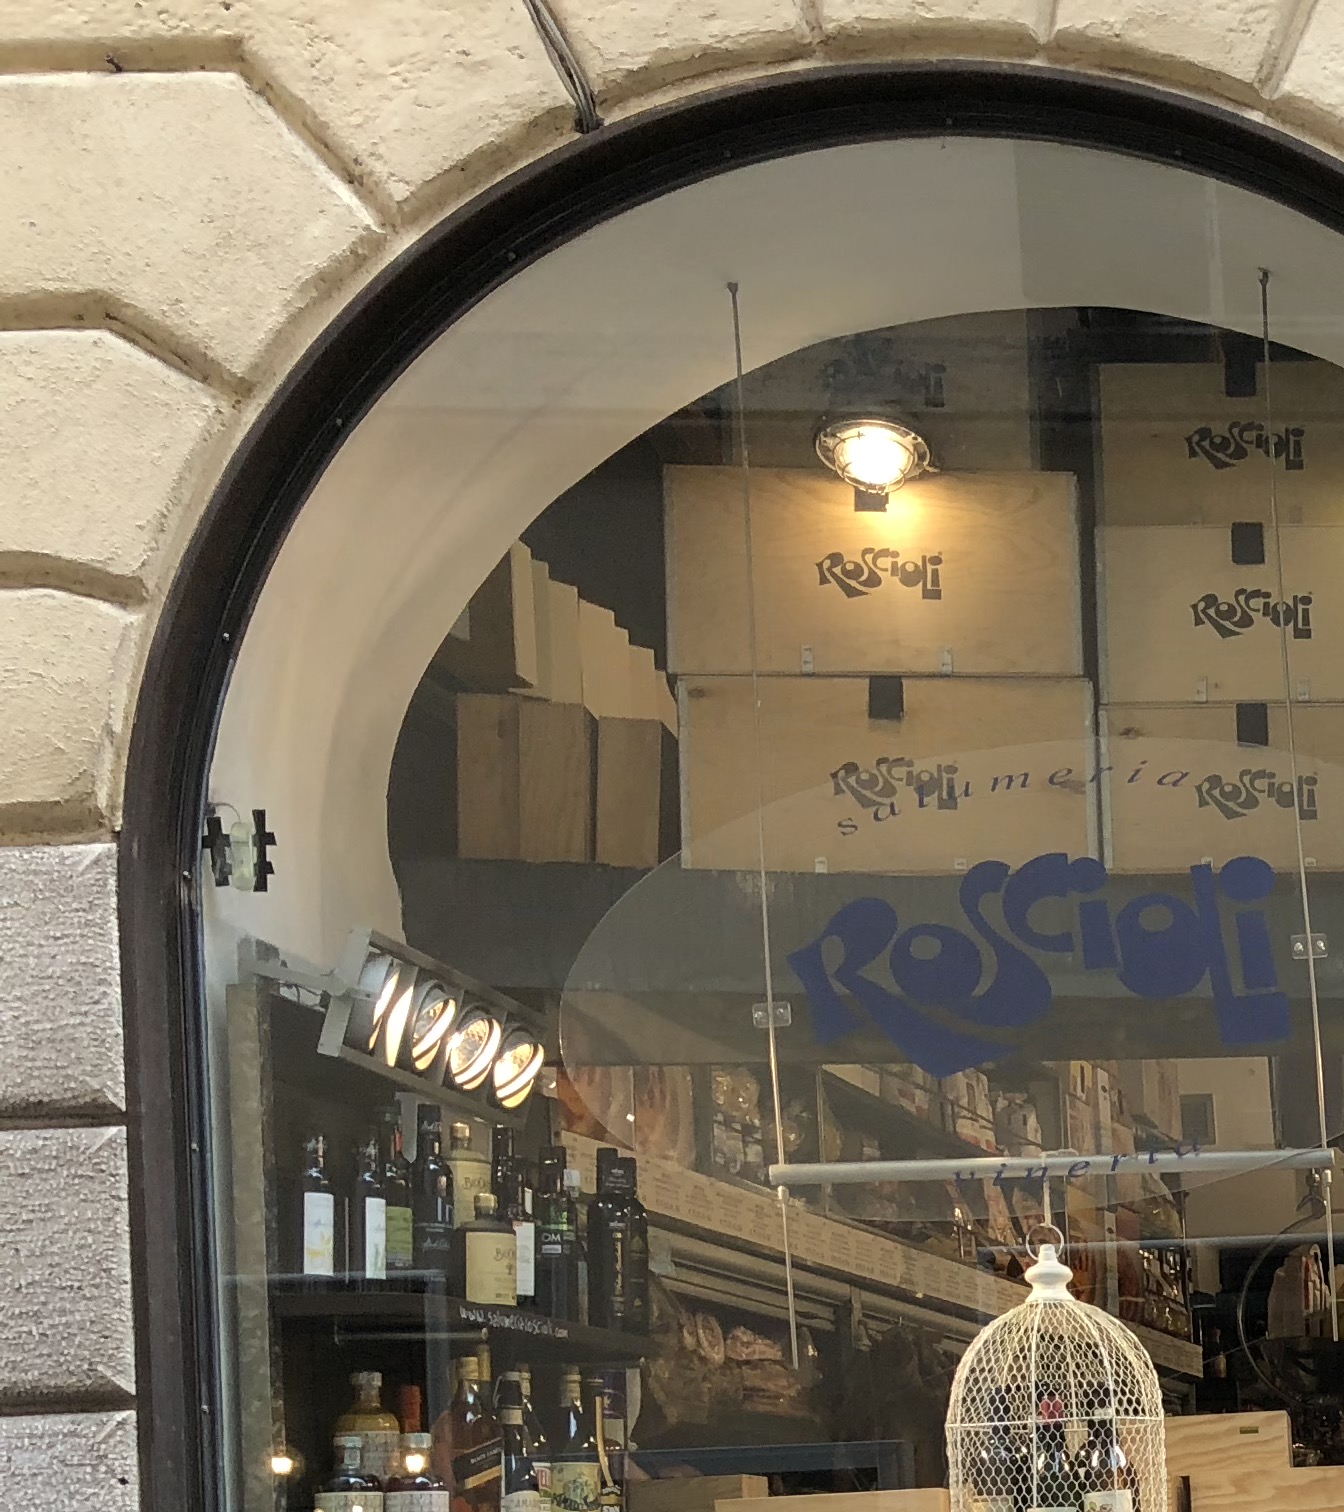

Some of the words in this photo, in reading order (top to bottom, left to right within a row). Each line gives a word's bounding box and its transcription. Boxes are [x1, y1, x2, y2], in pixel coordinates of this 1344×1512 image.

[815, 548, 944, 600] Roscioli
[1190, 588, 1314, 639] Roscioli
[836, 758, 1191, 837] salumeria
[786, 852, 1291, 1080] Roscioli
